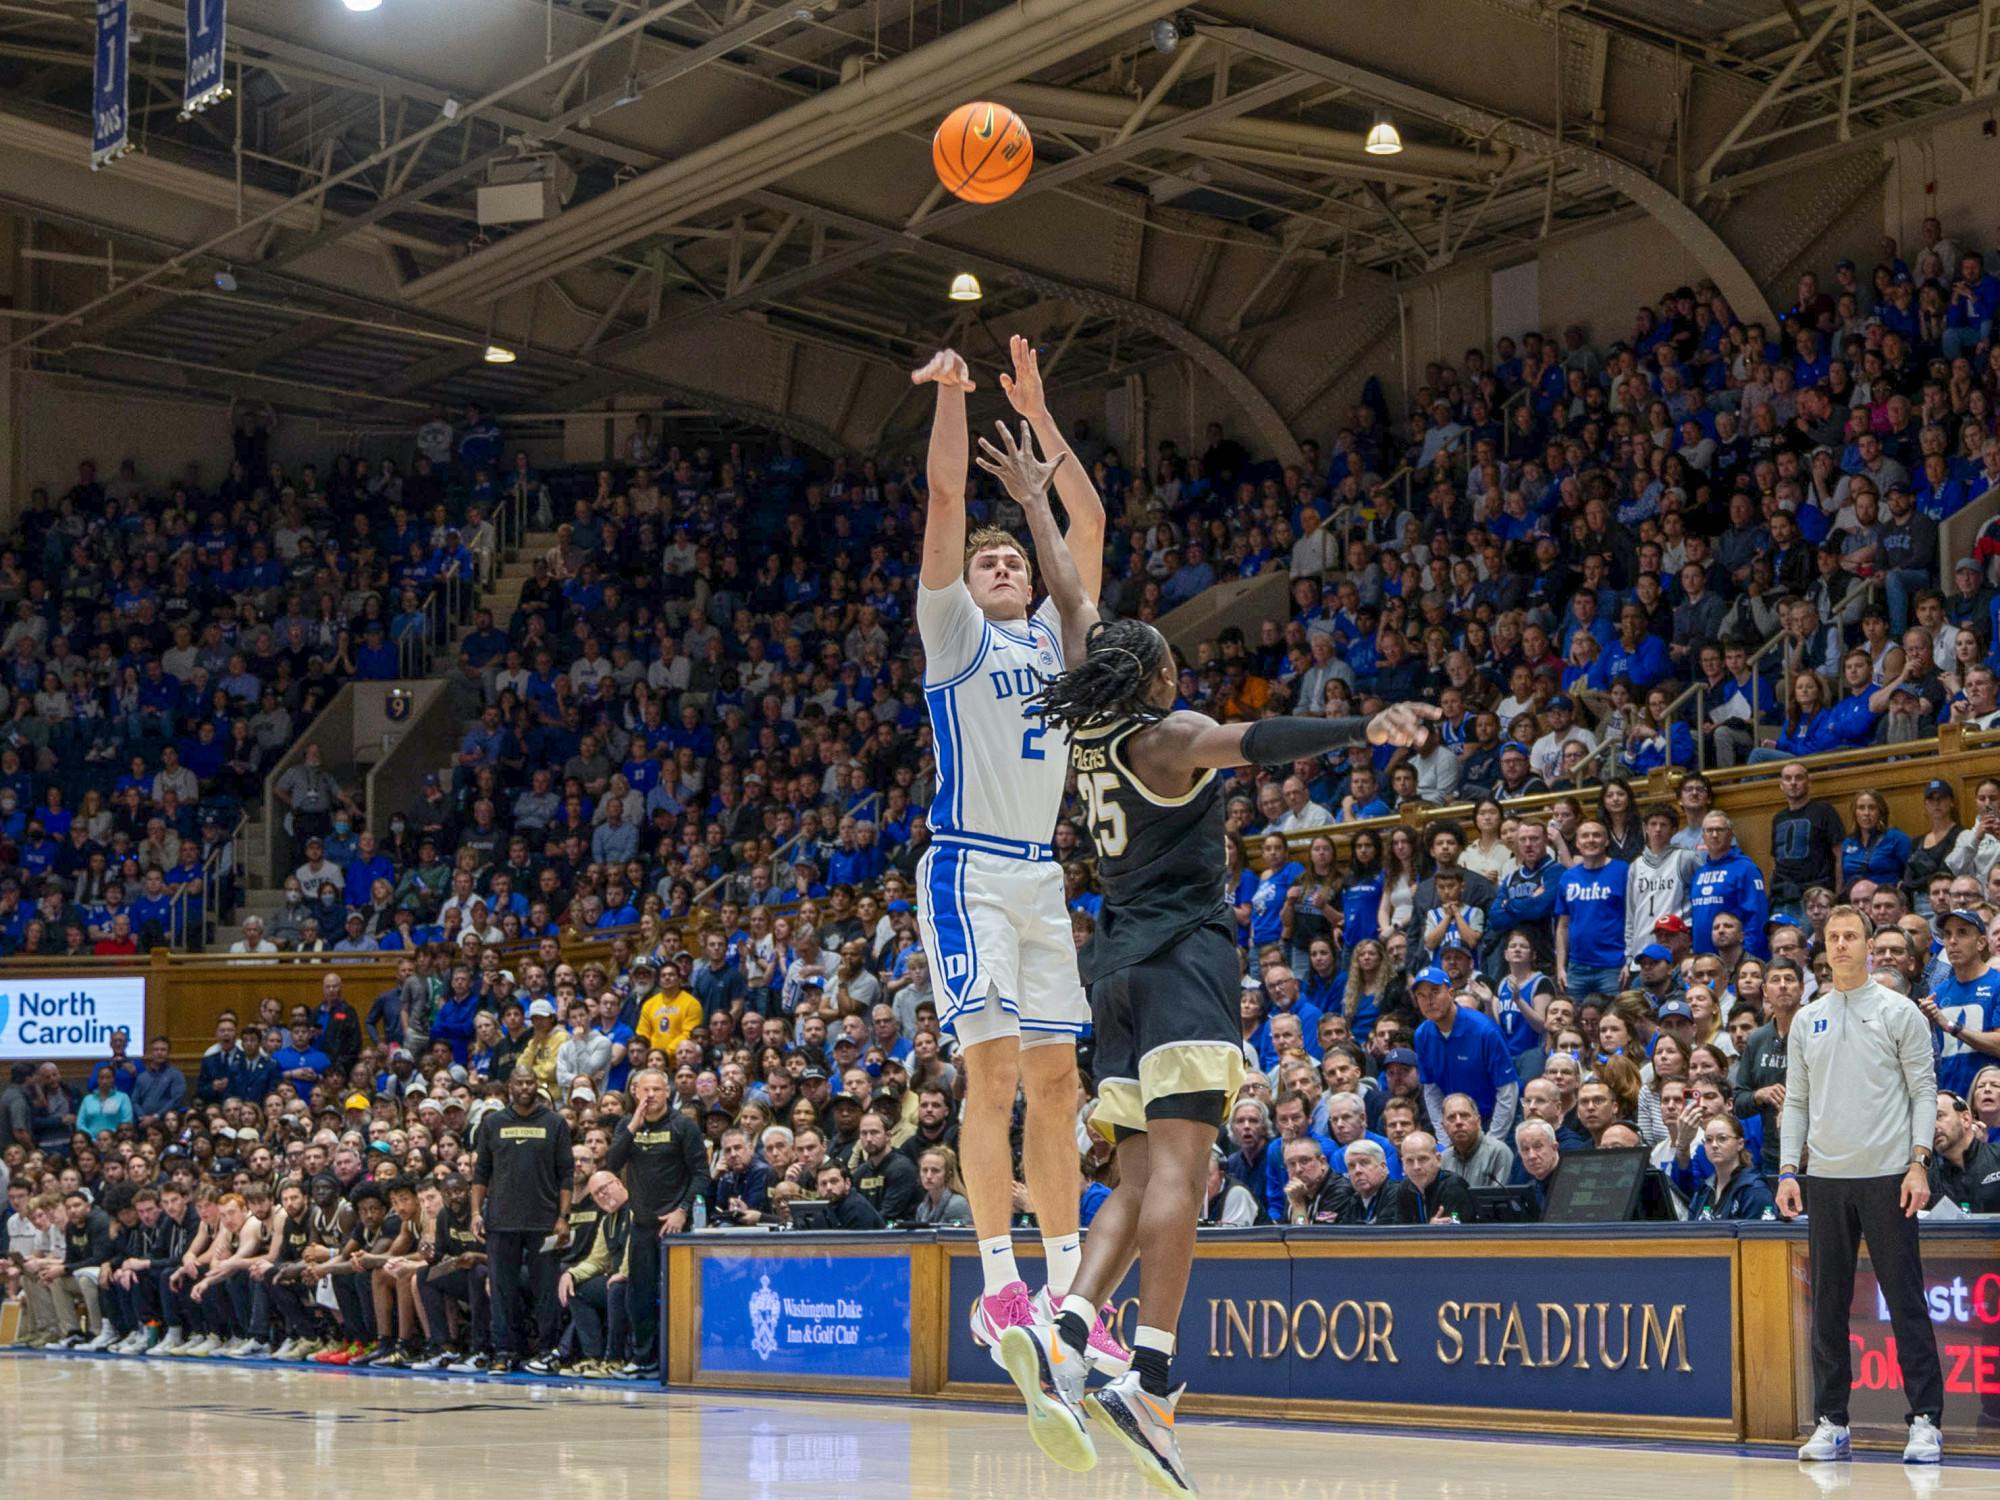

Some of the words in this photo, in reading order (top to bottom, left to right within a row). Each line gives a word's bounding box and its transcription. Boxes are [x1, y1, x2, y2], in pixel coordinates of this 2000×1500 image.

[392, 698, 405, 717] 9
[1021, 705, 1046, 760] 2
[1077, 772, 1128, 857] 25
[1638, 877, 1674, 893] Duke
[1697, 870, 1728, 885] DUKE
[1566, 882, 1612, 902] Duke
[1649, 895, 1654, 917] 1
[945, 954, 967, 980] D
[18, 991, 96, 1017] North
[1505, 1013, 1513, 1033] 1
[783, 1298, 836, 1322] Washington
[837, 1298, 863, 1319] Duke
[787, 1324, 803, 1343] Inn
[803, 1326, 813, 1343] &
[813, 1325, 835, 1344] Golf
[835, 1325, 858, 1345] Club
[1207, 1298, 1399, 1364] INDOOR
[1436, 1300, 1693, 1373] STADIUM
